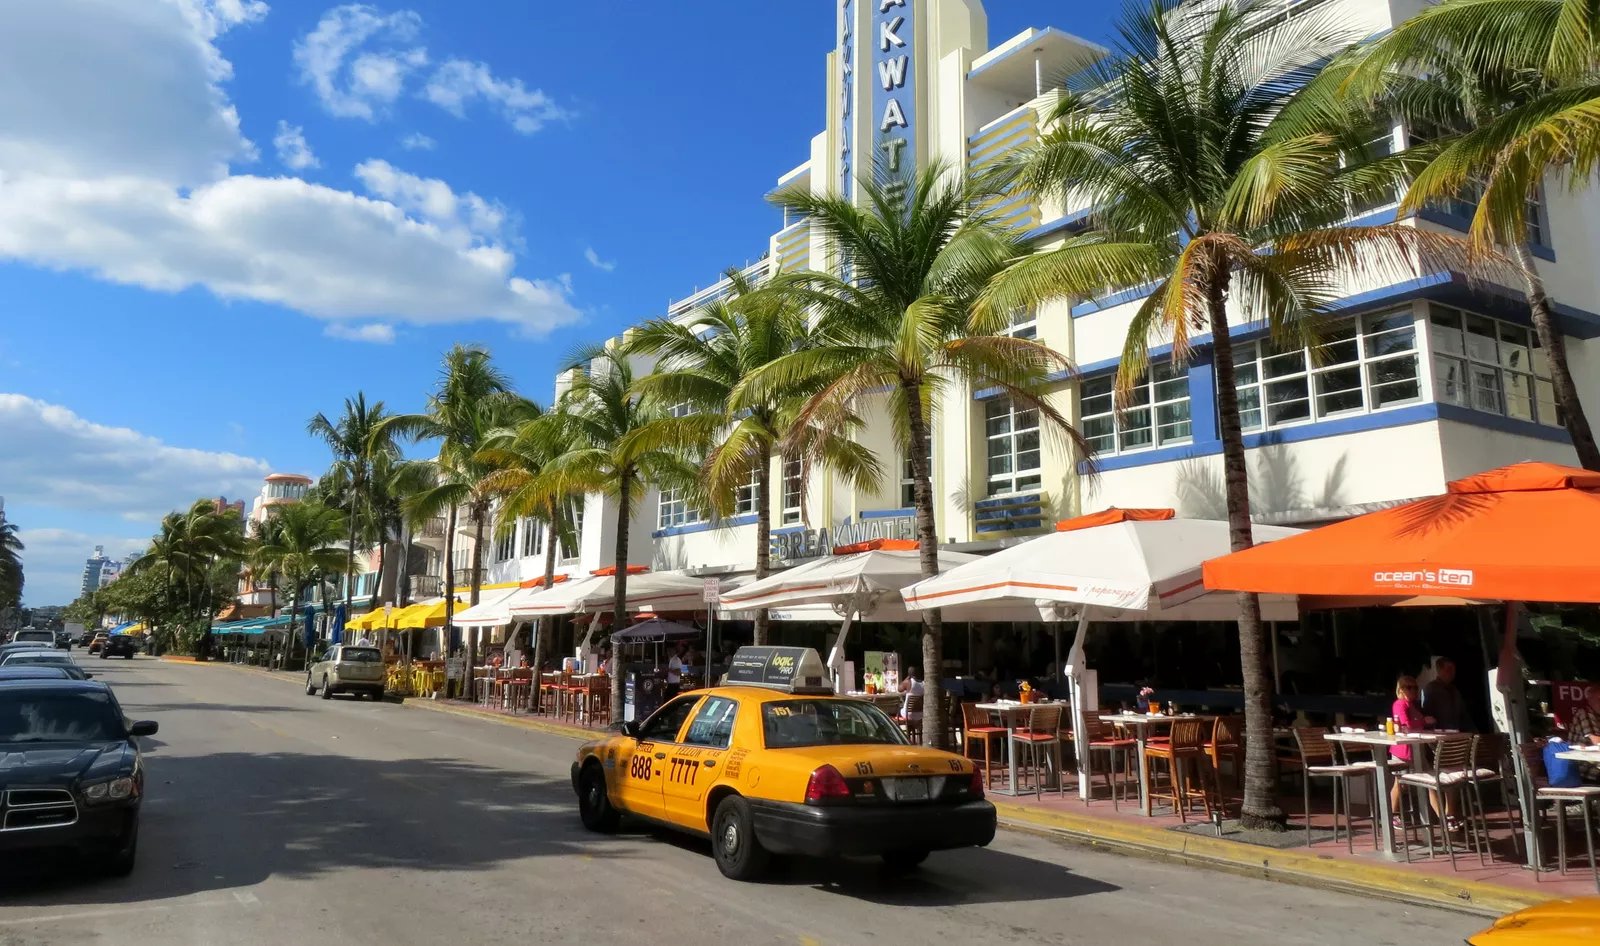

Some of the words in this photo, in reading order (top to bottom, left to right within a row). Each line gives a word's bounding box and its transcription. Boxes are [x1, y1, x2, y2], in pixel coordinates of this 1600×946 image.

[778, 517, 919, 559] BREAKWATE
[1374, 568, 1436, 582] ocean's
[1440, 569, 1472, 584] ten
[780, 667, 794, 675] PRO
[773, 706, 793, 717] 151
[854, 761, 874, 775] 151
[947, 759, 964, 772] 151
